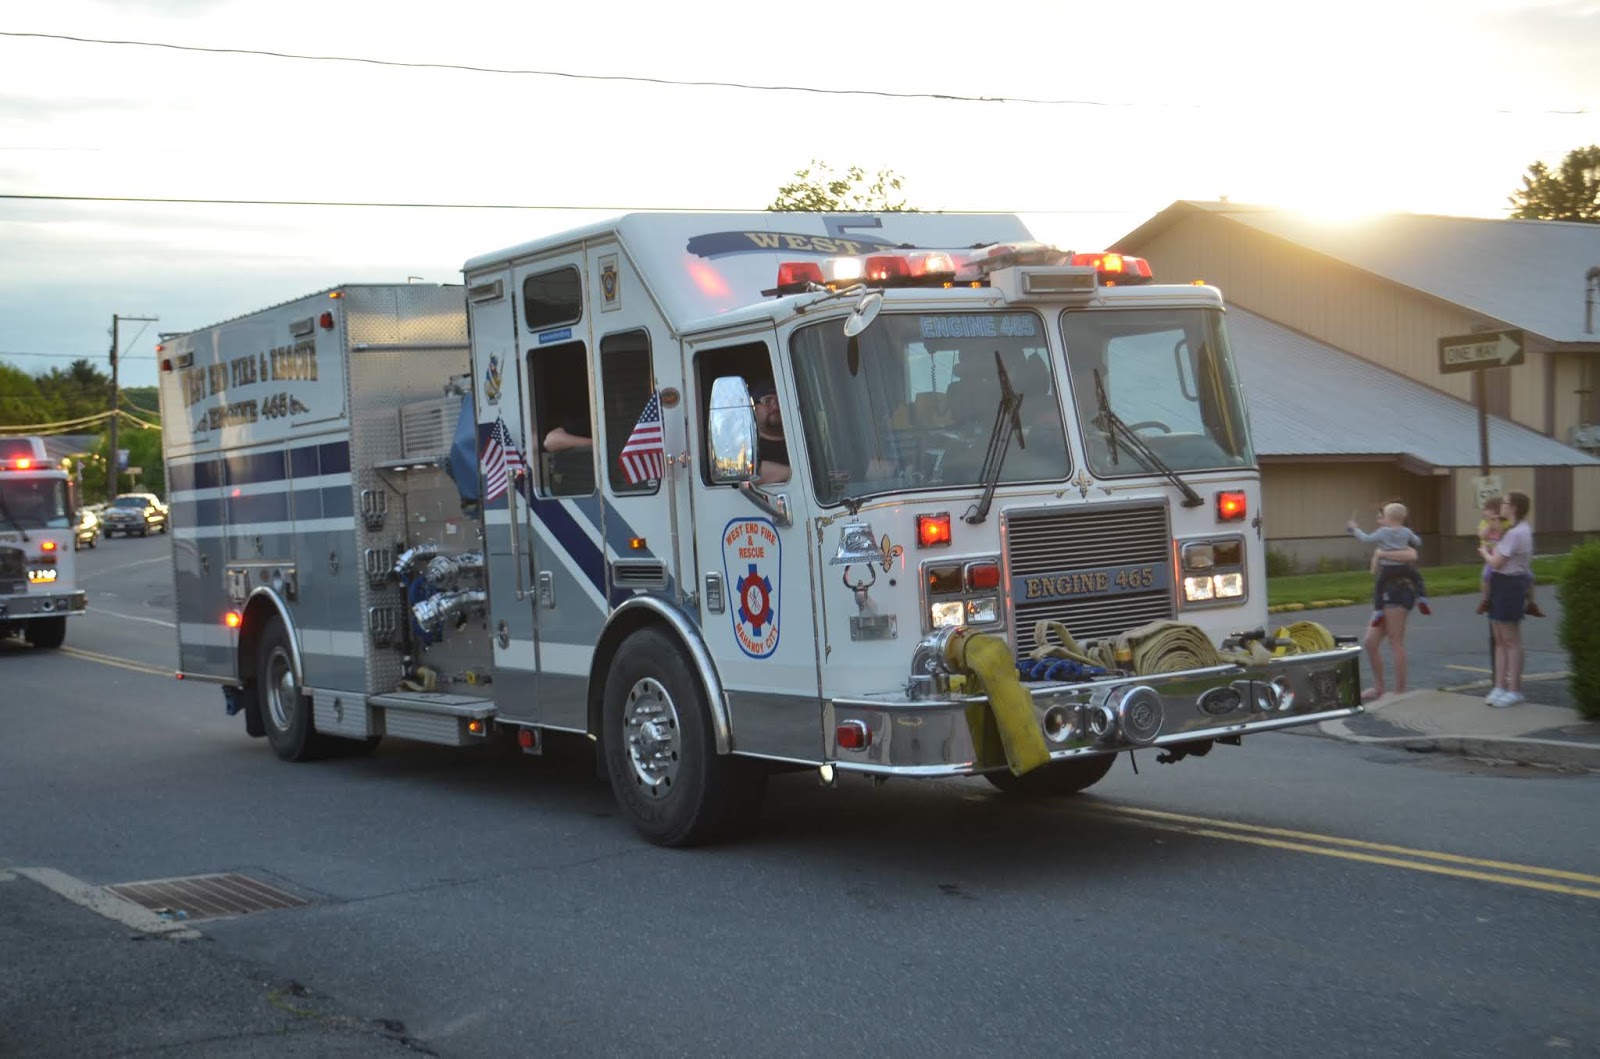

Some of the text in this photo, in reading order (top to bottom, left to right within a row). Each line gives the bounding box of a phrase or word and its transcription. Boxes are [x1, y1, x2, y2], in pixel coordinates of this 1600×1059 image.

[744, 232, 861, 256] WEST
[920, 315, 1035, 338] ENGINE 465
[1448, 342, 1498, 362] ONE WAY
[261, 392, 288, 419] 465
[726, 523, 777, 546] WEST END FIRE
[747, 535, 753, 546] &
[739, 547, 764, 559] RESCUE
[1025, 567, 1154, 599] ENGINE 465
[735, 622, 778, 653] MAHANOY CITY
